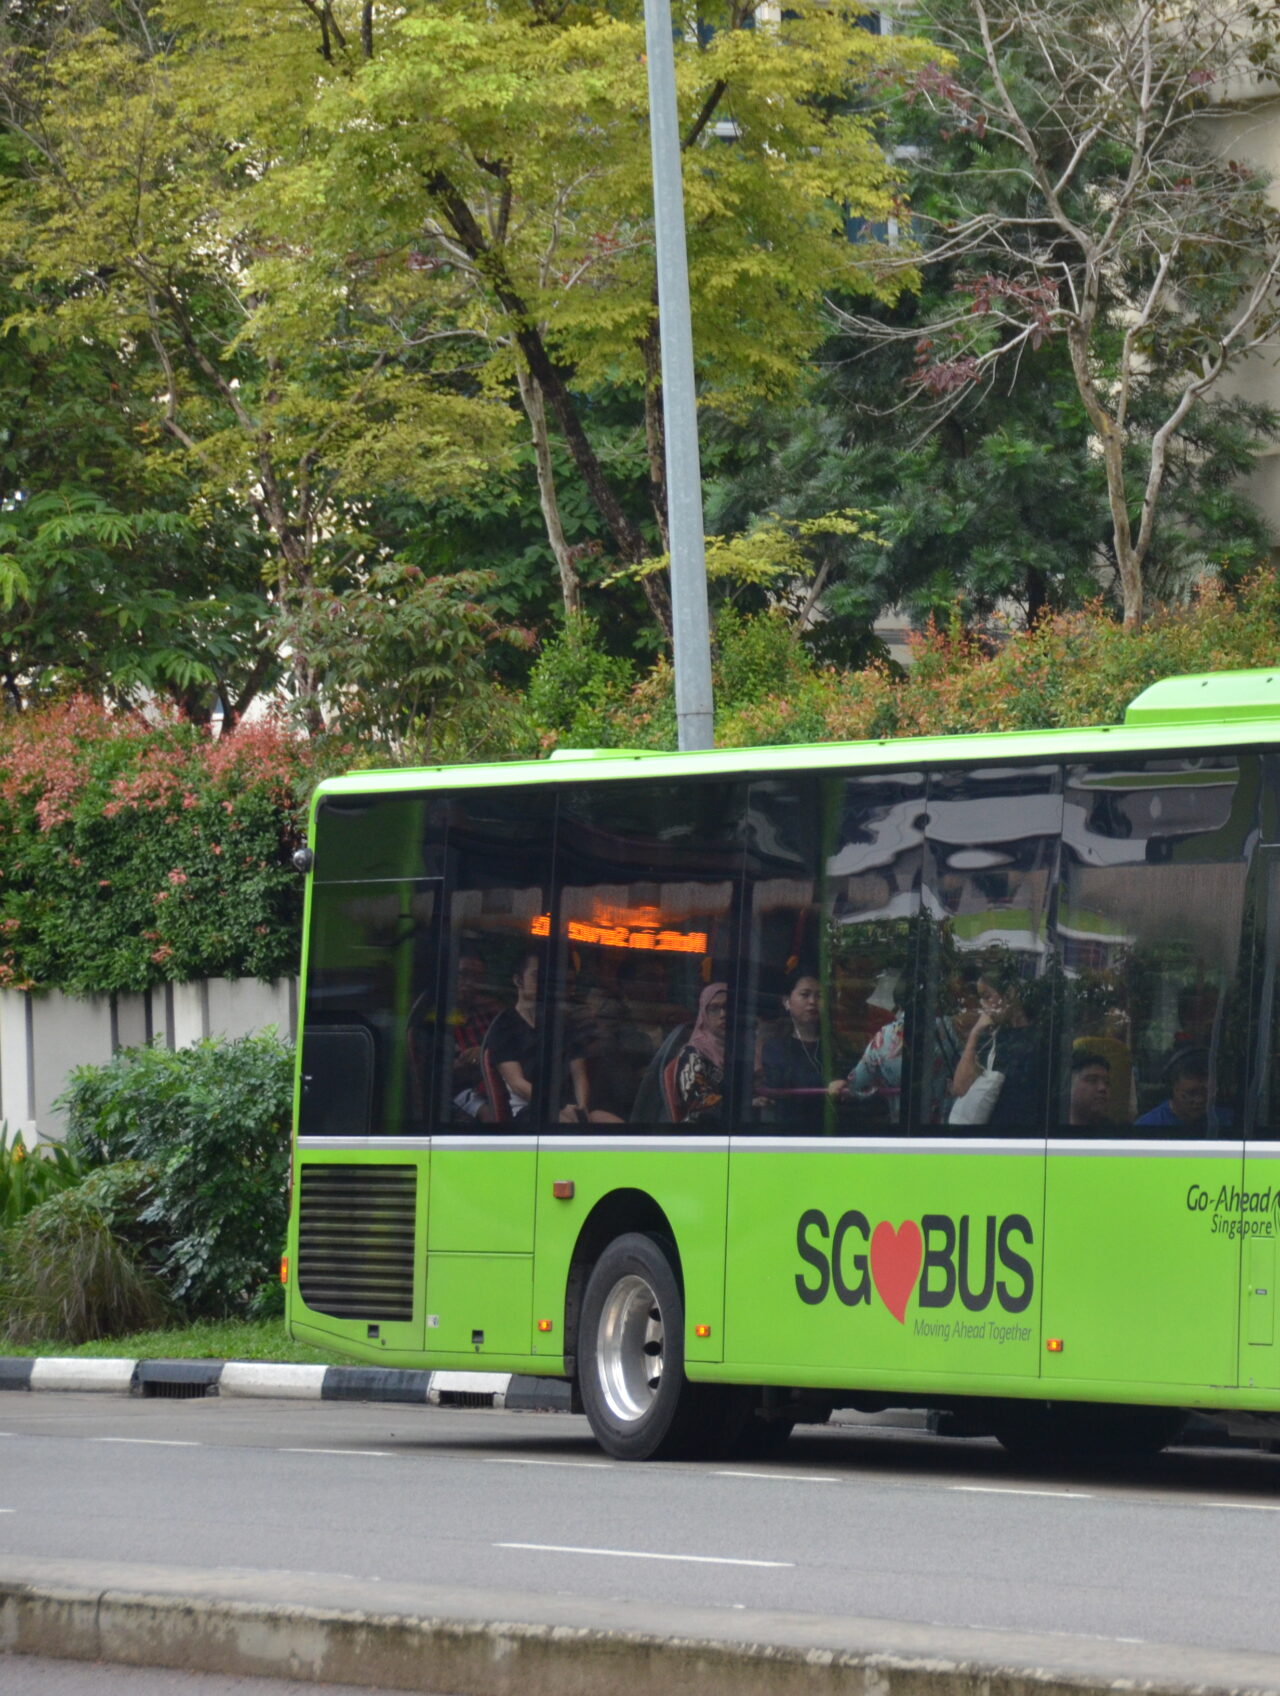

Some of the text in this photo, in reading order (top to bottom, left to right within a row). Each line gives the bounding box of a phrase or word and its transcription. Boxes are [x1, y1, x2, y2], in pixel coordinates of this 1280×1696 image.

[1186, 1184, 1272, 1213] Go-Ahead
[1210, 1213, 1272, 1239] Singapore
[913, 1319, 1032, 1344] Moving Ahead Together
